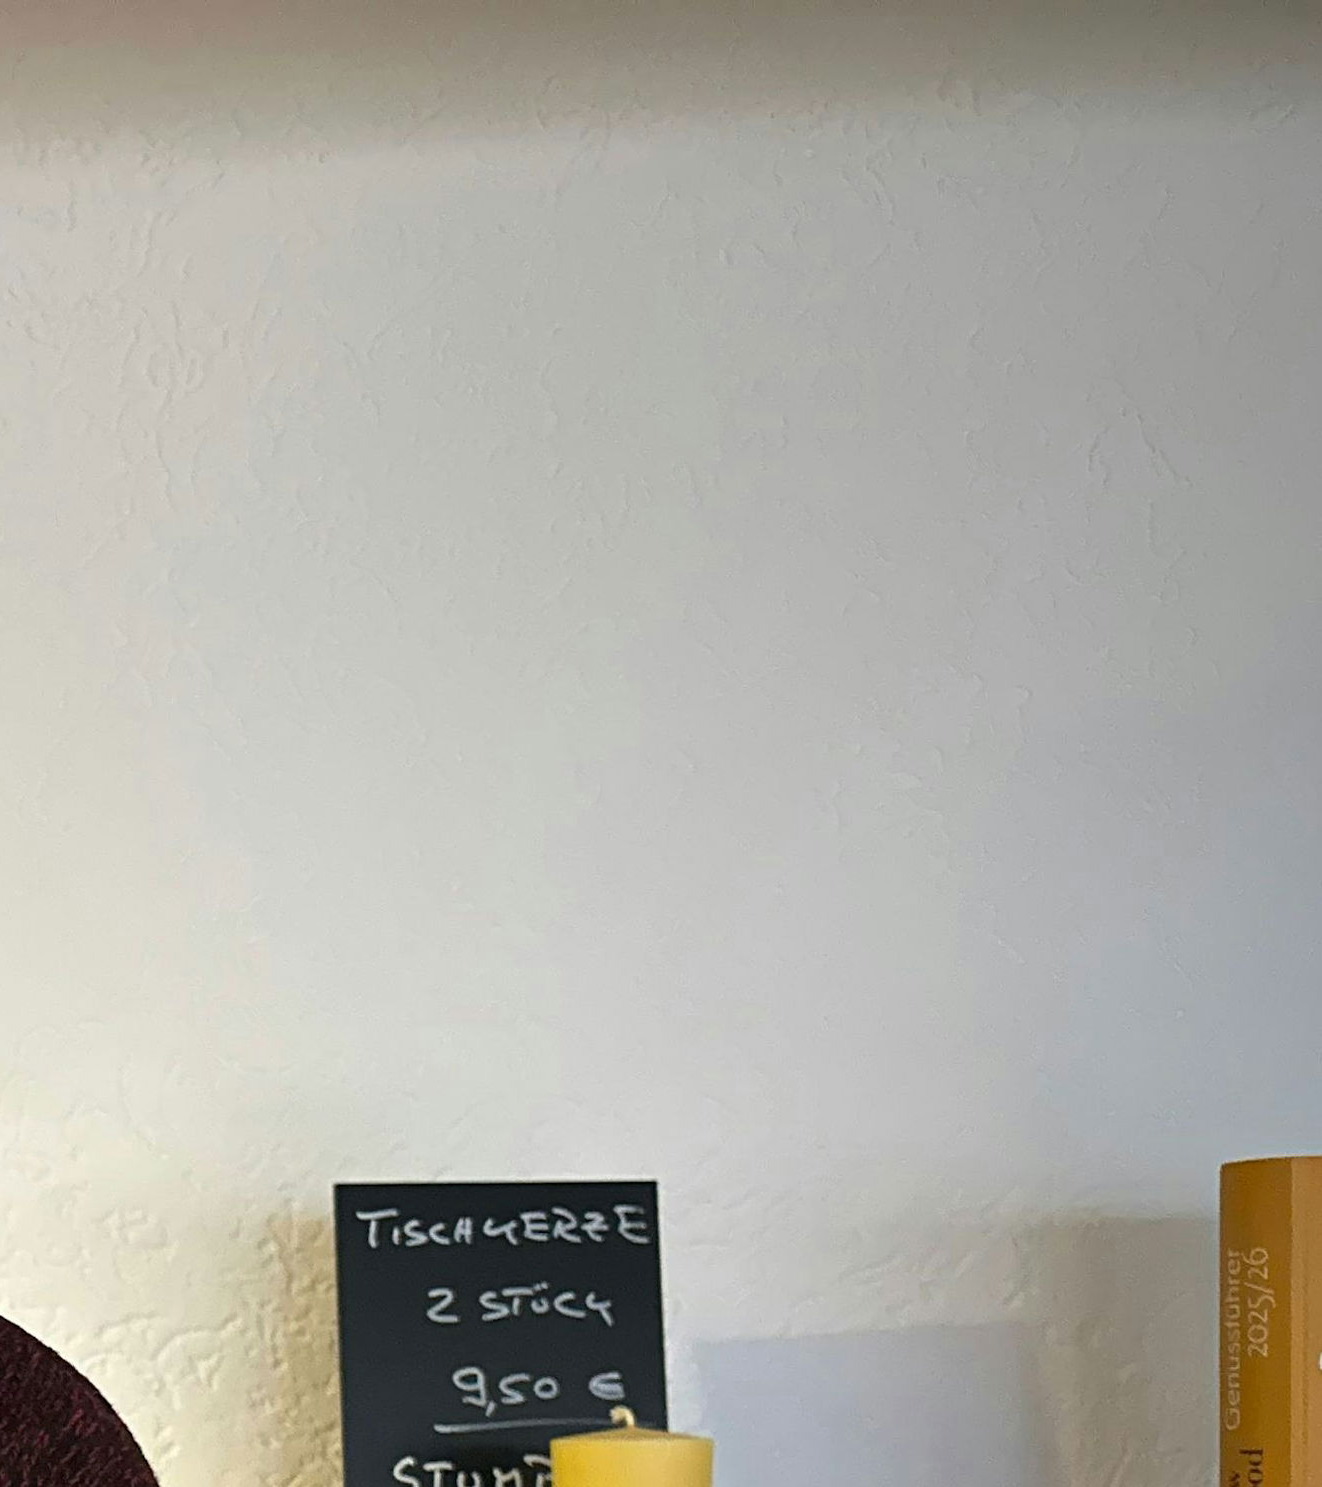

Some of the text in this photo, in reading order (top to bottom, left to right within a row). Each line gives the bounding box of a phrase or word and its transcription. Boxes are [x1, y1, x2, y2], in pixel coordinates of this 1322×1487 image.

[426, 1282, 615, 1328] 2 STÜCK
[1243, 1246, 1276, 1358] 2025/26
[452, 1365, 560, 1418] 9,50
